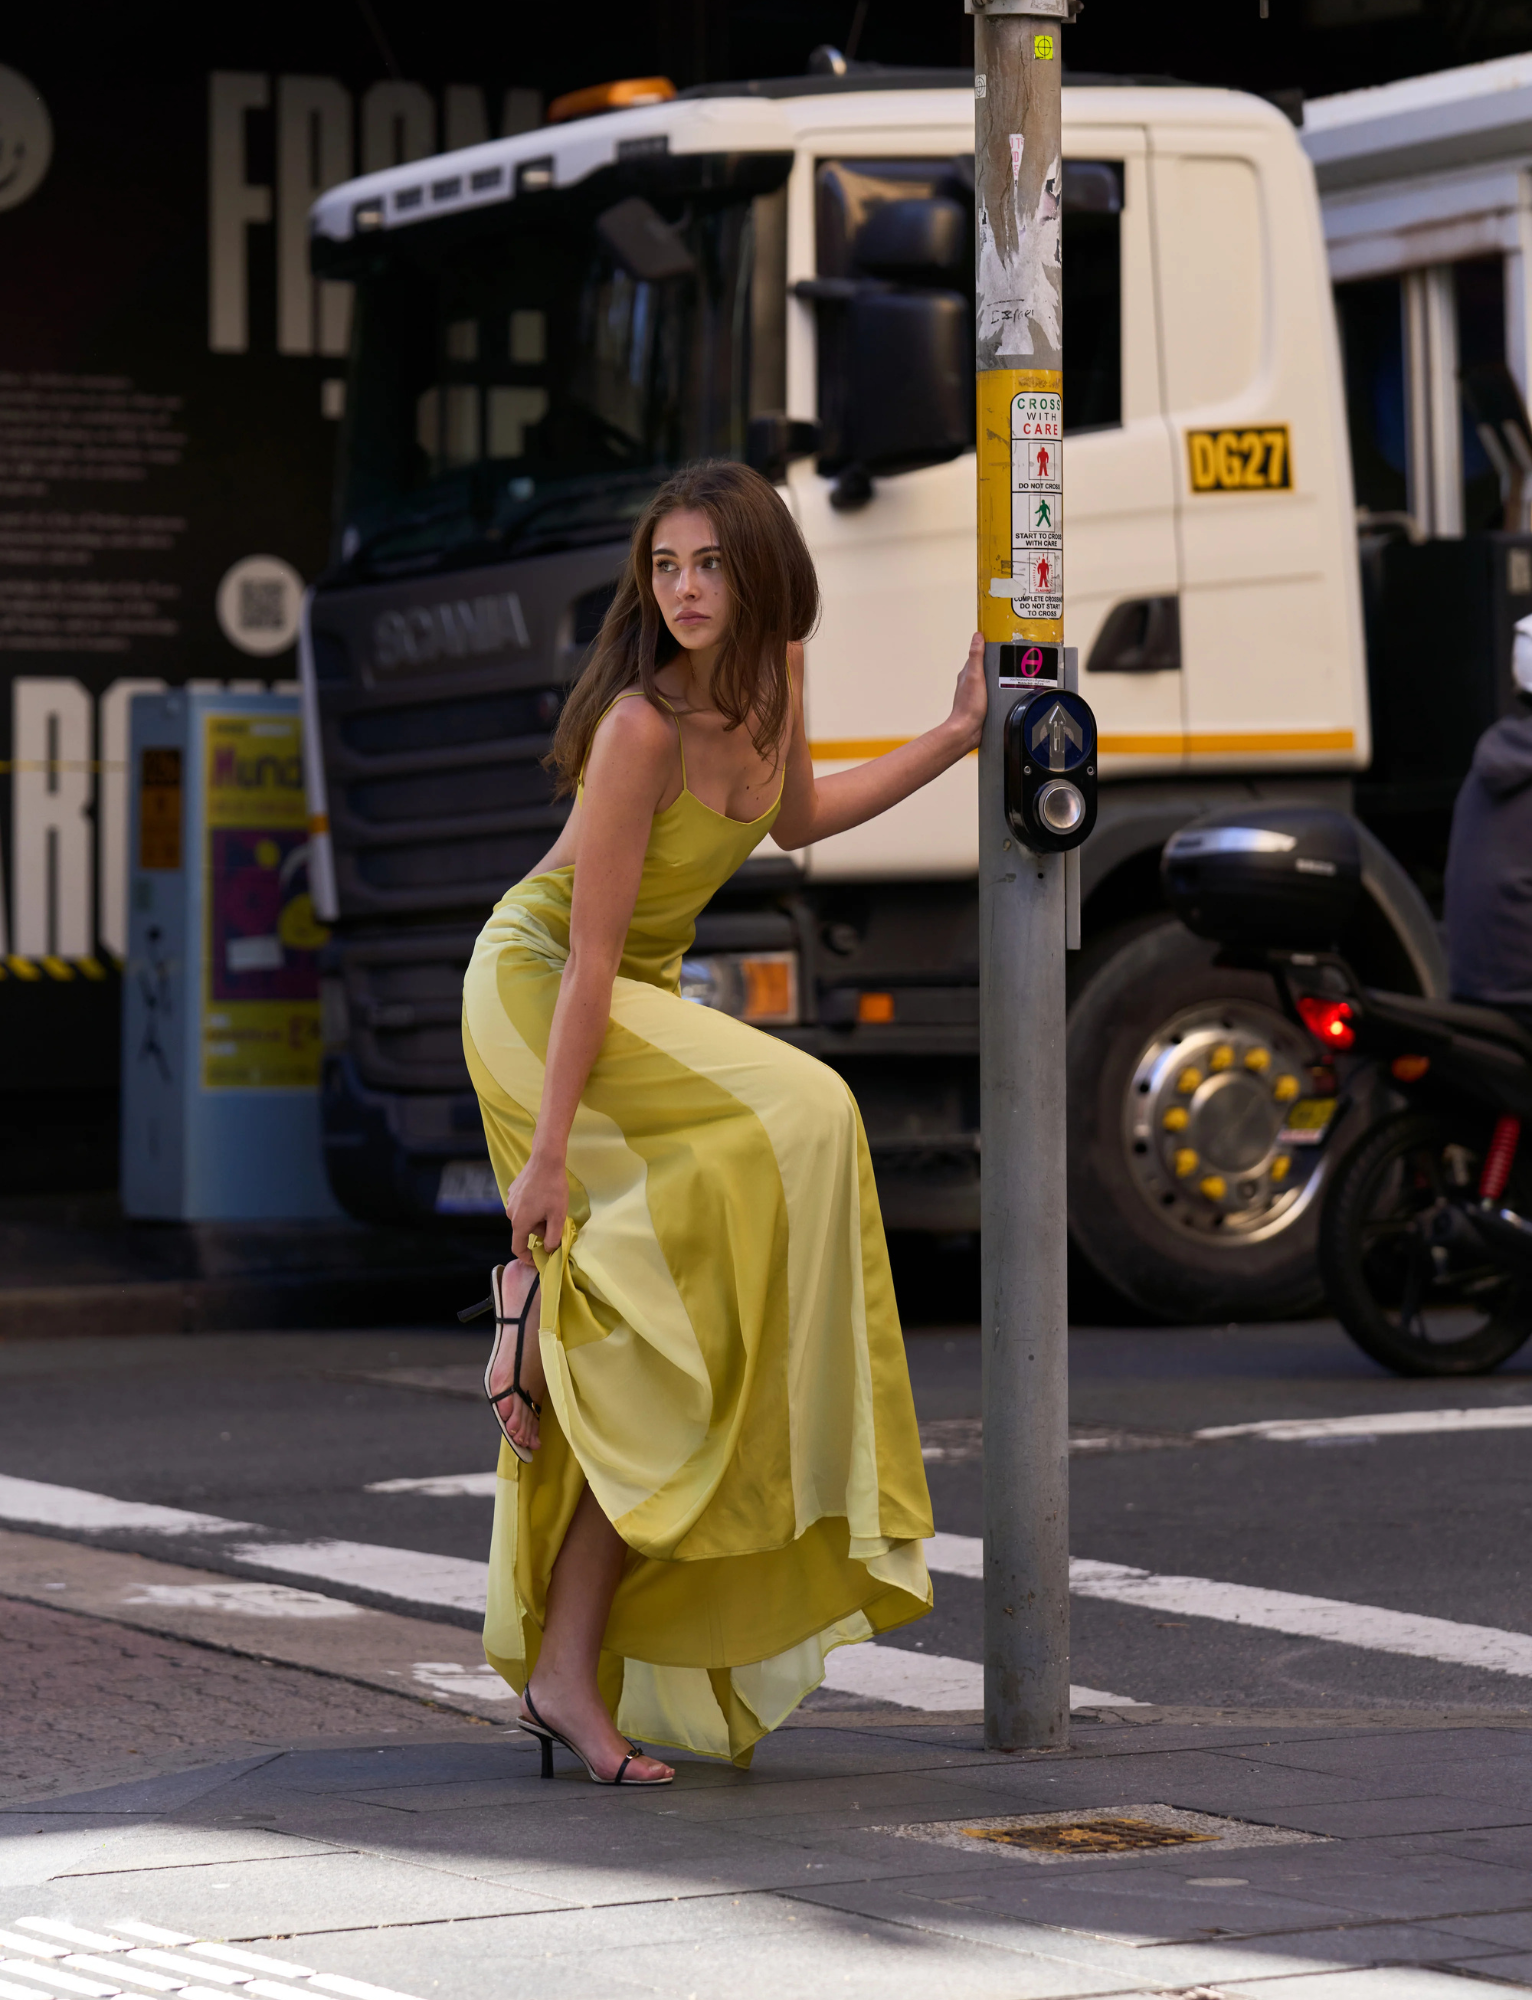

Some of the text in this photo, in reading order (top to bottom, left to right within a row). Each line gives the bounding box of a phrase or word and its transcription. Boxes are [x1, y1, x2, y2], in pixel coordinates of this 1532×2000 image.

[1017, 398, 1061, 411] CROSS
[1026, 412, 1057, 421] WITH
[1023, 423, 1058, 435] CARE
[1191, 431, 1286, 488] DG27
